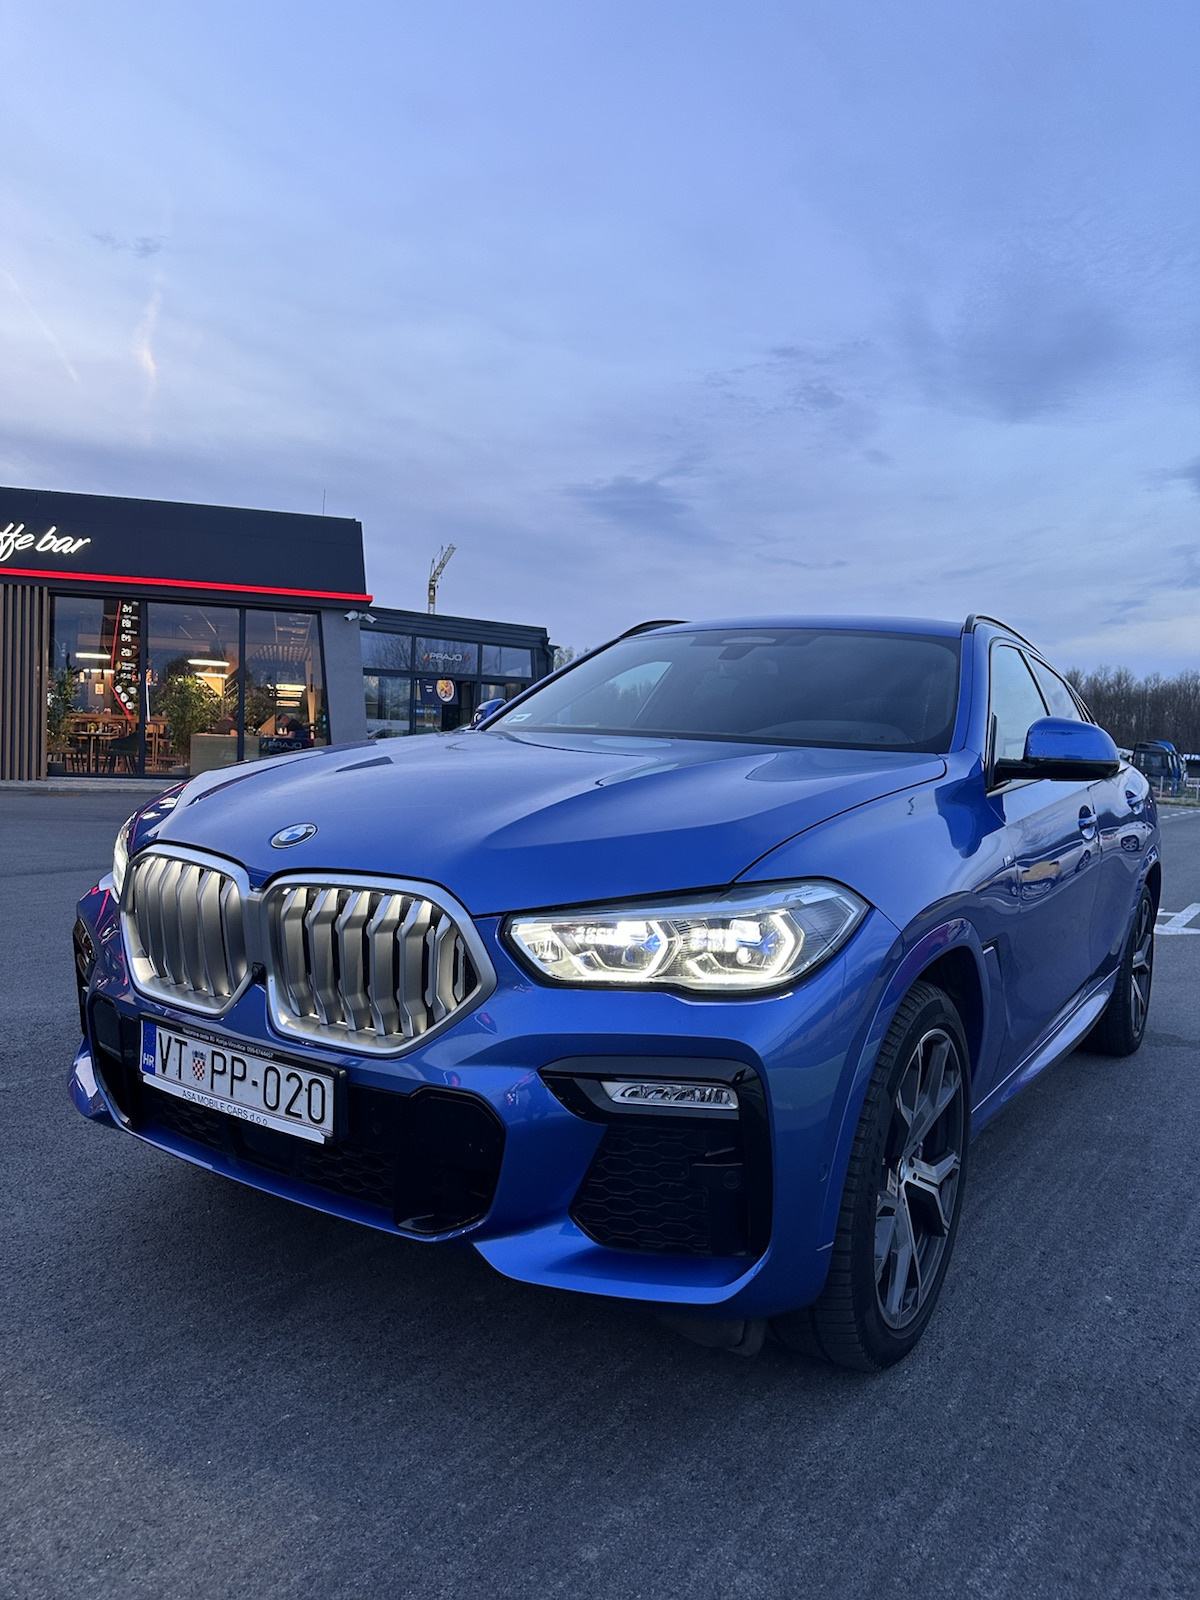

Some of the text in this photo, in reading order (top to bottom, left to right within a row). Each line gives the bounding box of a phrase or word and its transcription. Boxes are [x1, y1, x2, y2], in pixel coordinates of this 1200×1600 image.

[35, 525, 91, 554] bar
[143, 1053, 155, 1068] HR
[158, 1032, 188, 1080] VT
[211, 1050, 326, 1124] PP-020
[182, 1090, 197, 1101] ASA
[197, 1094, 225, 1112] MOBILE
[226, 1104, 248, 1120] CARS
